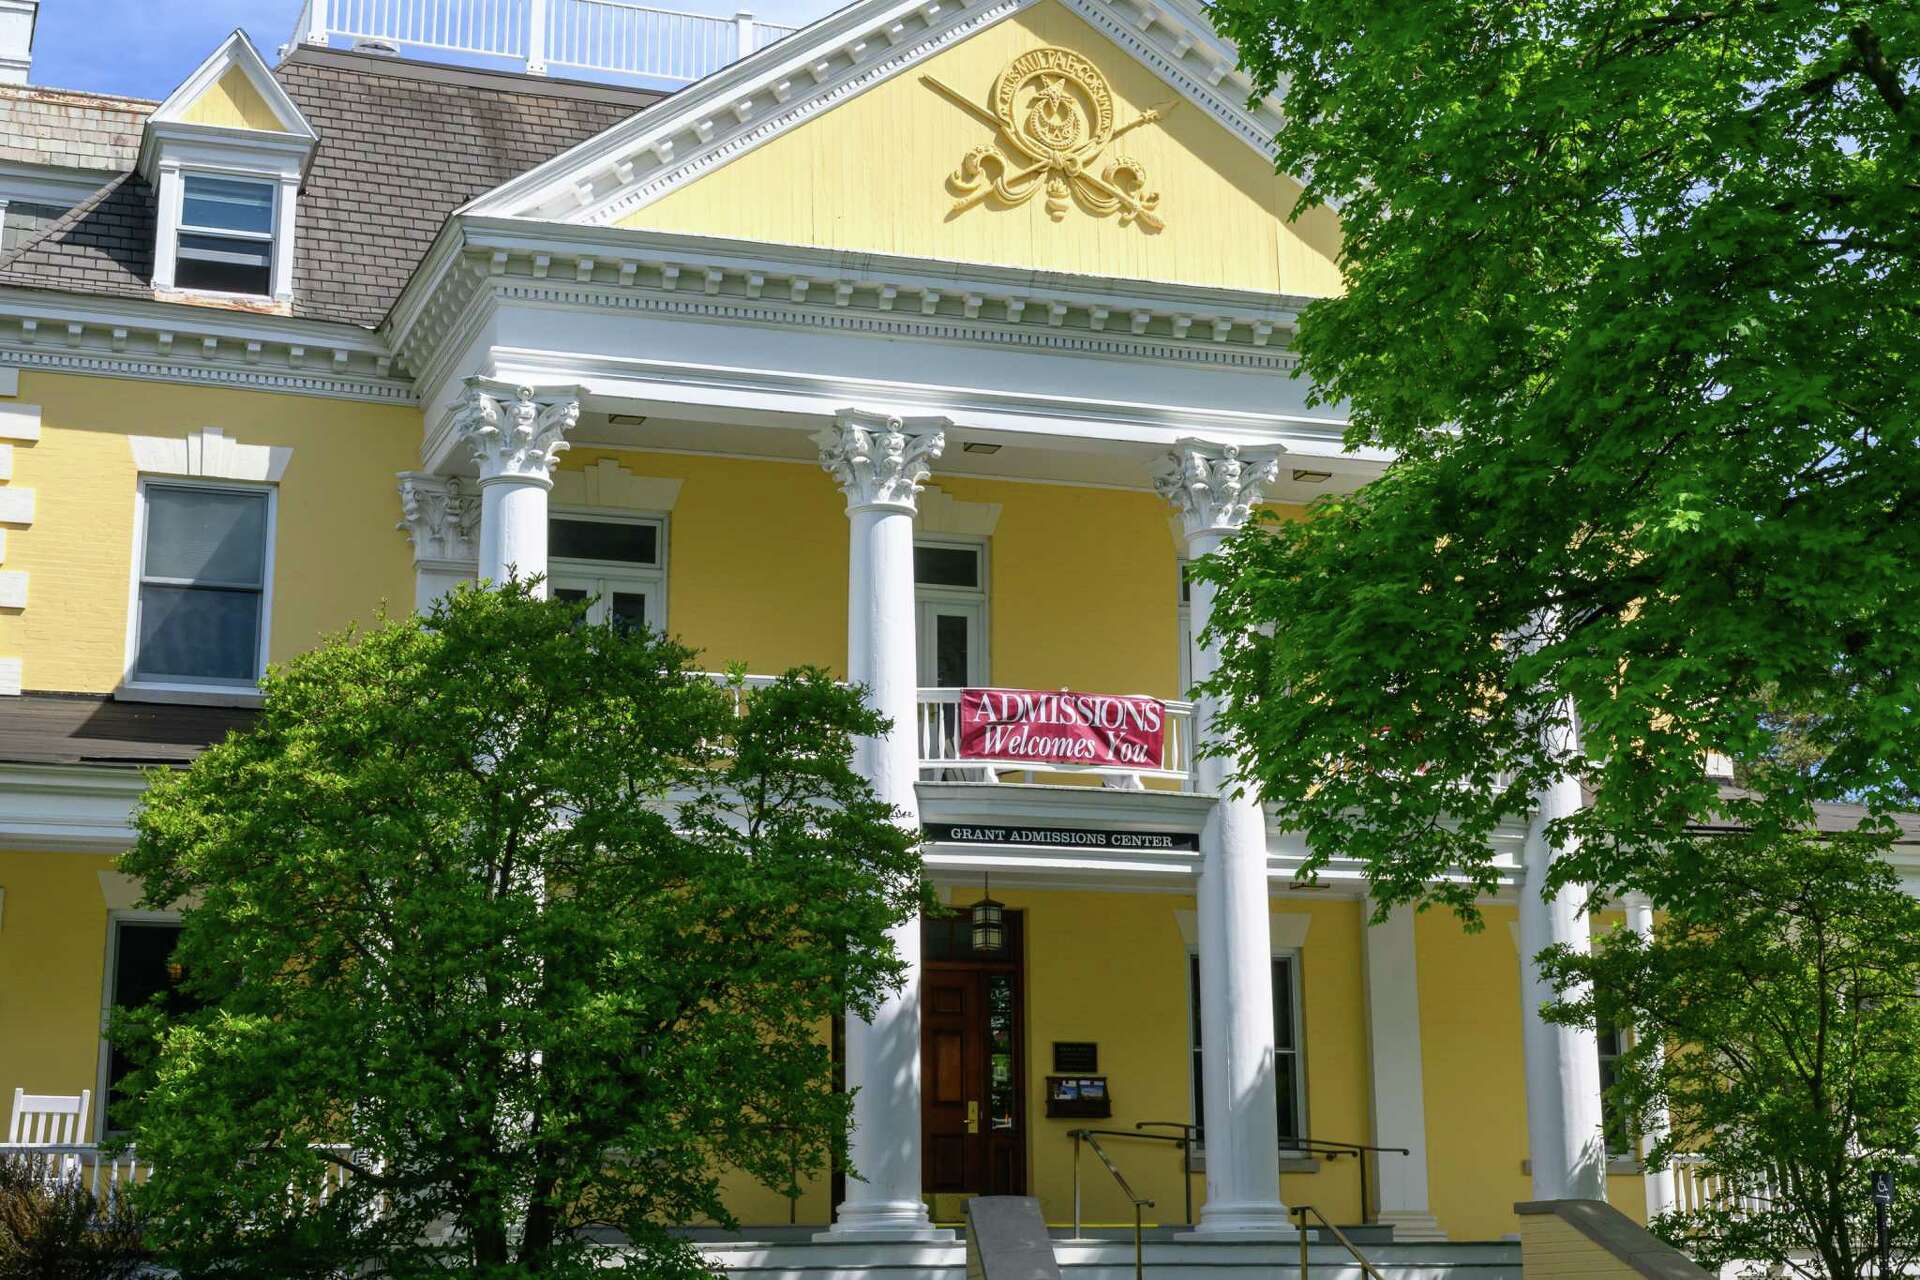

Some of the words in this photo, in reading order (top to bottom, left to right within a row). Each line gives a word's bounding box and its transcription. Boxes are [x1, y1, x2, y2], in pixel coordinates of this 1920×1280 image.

[974, 693, 1161, 733] ADMISSIONS
[984, 725, 1096, 758] Welcomes
[1106, 731, 1148, 762] You
[950, 827, 1006, 842] GRANT
[1010, 830, 1106, 845] ADMISSIONS
[1111, 834, 1173, 848] CENTER
